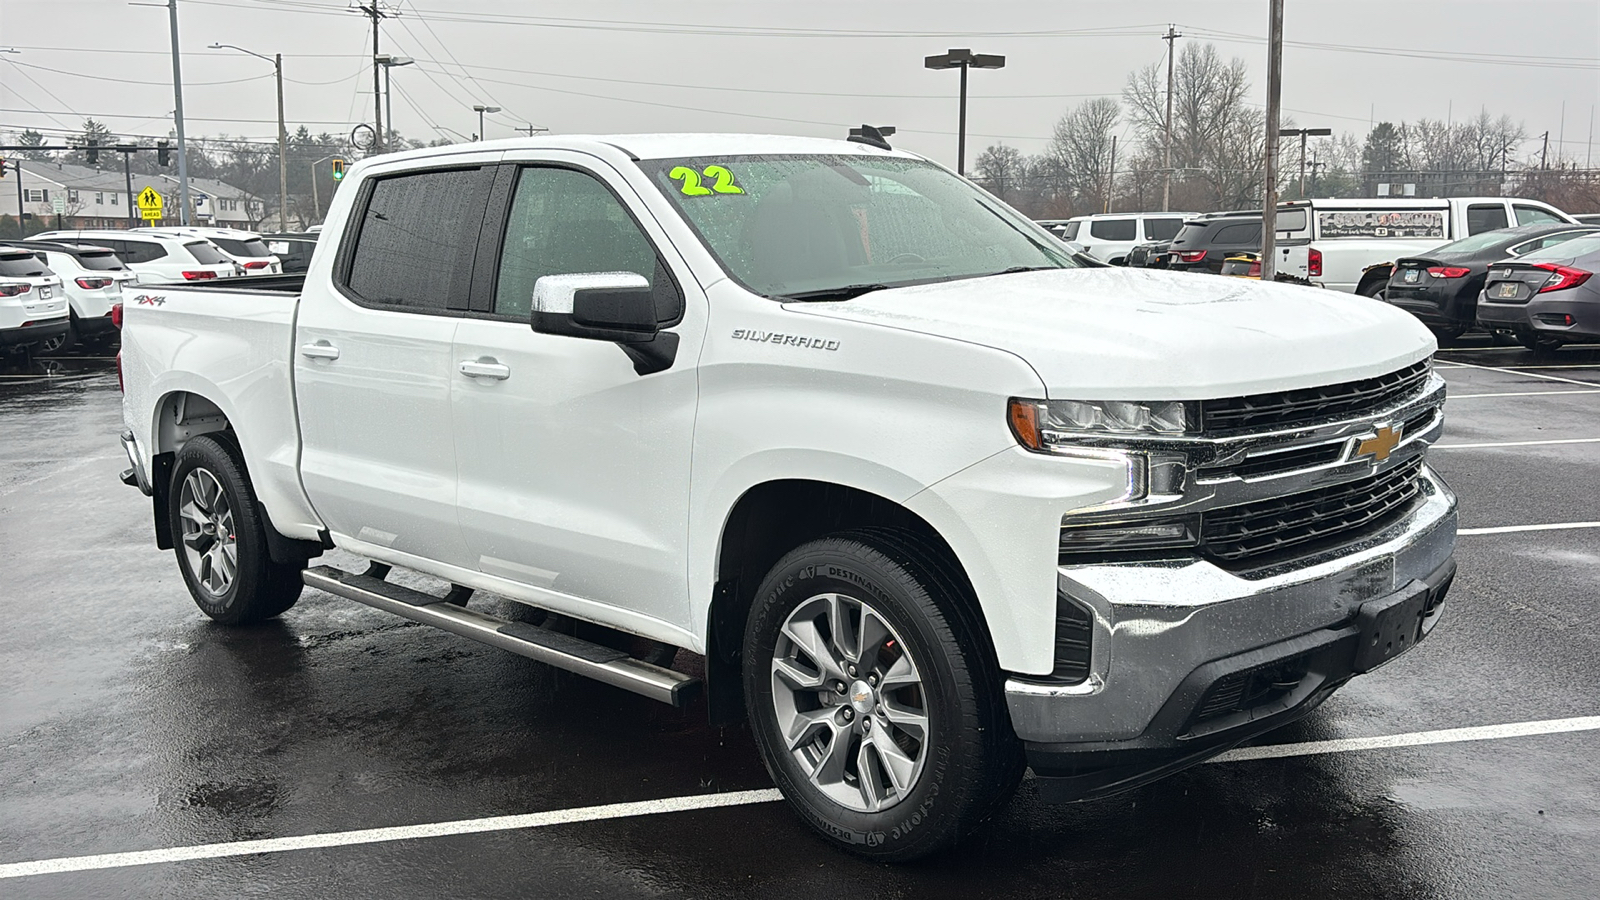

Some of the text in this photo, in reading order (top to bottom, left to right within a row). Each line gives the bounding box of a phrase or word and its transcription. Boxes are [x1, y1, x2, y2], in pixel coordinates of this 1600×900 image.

[669, 165, 745, 196] 22
[731, 329, 840, 351] SILVERADO
[829, 566, 899, 610] DESTINATION
